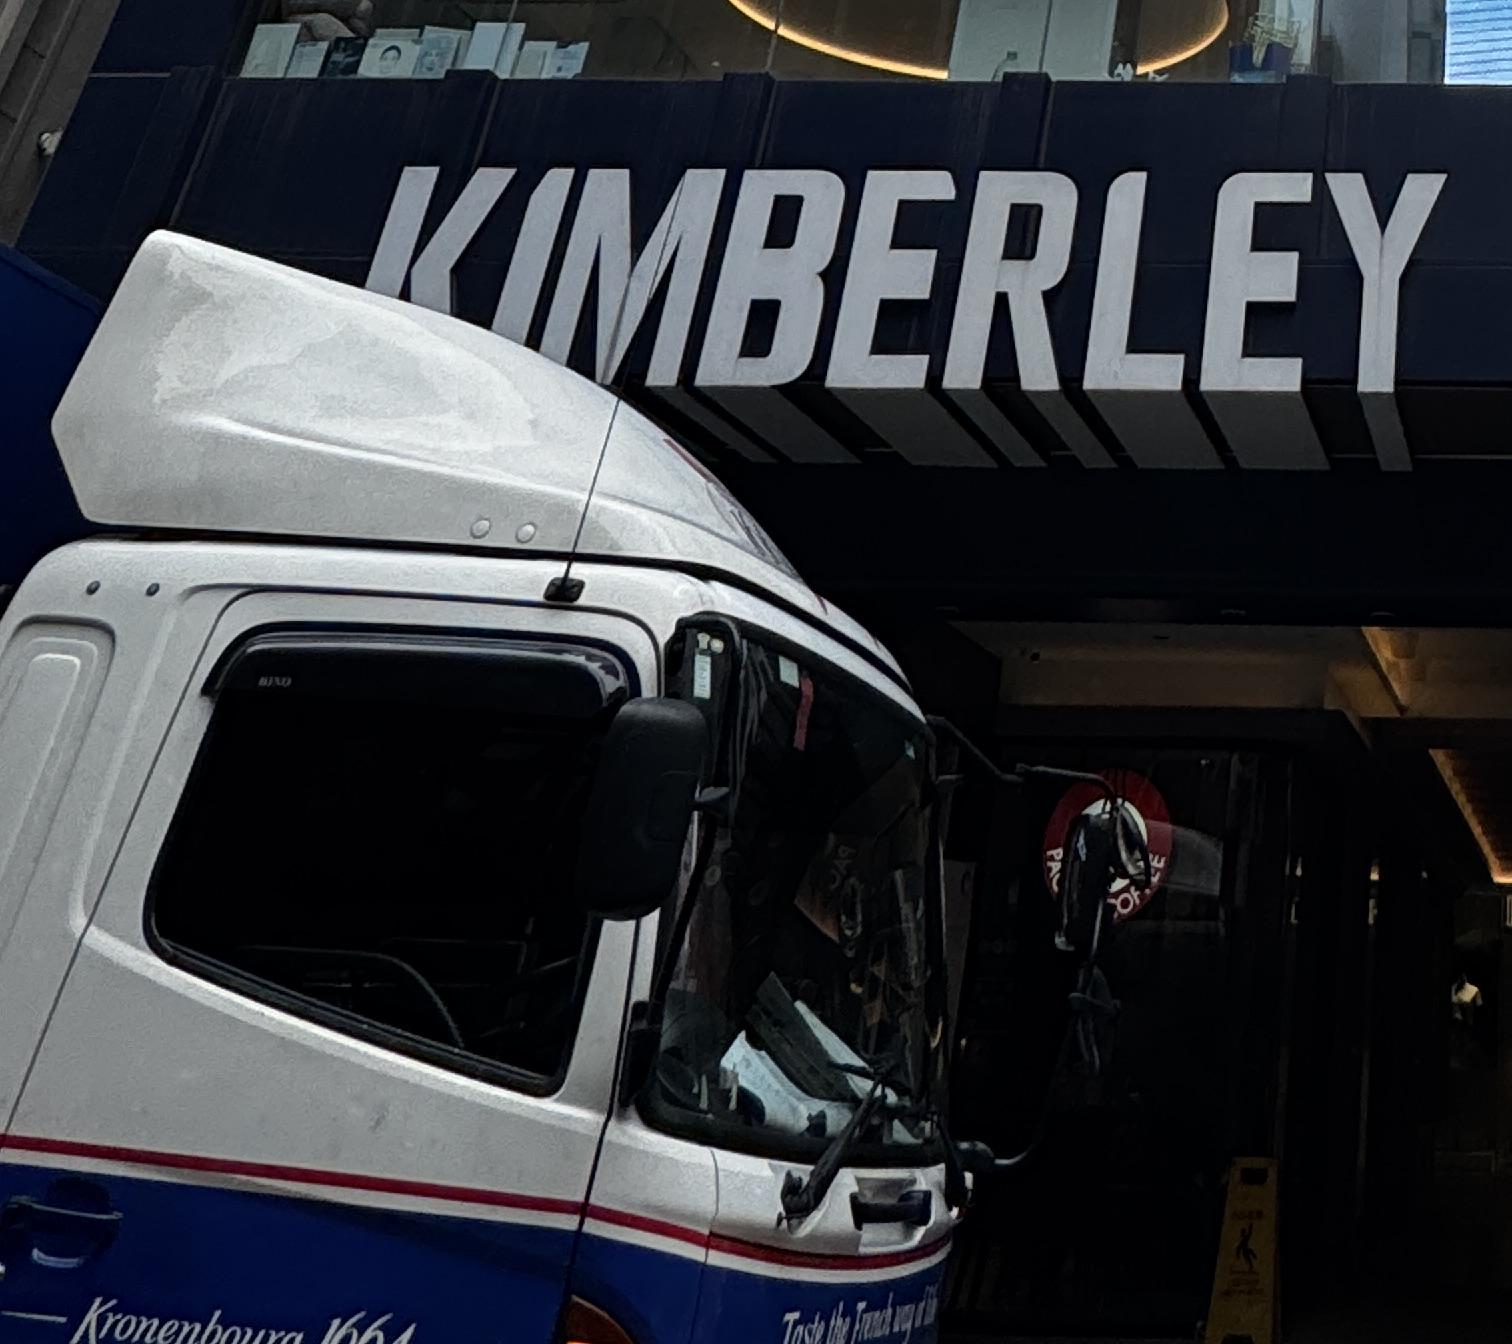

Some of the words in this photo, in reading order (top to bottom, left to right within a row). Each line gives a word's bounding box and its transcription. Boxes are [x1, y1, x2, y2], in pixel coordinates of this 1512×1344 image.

[364, 165, 1449, 393] KIMBERLEY
[782, 1310, 826, 1344] Taste
[826, 1300, 852, 1344] the
